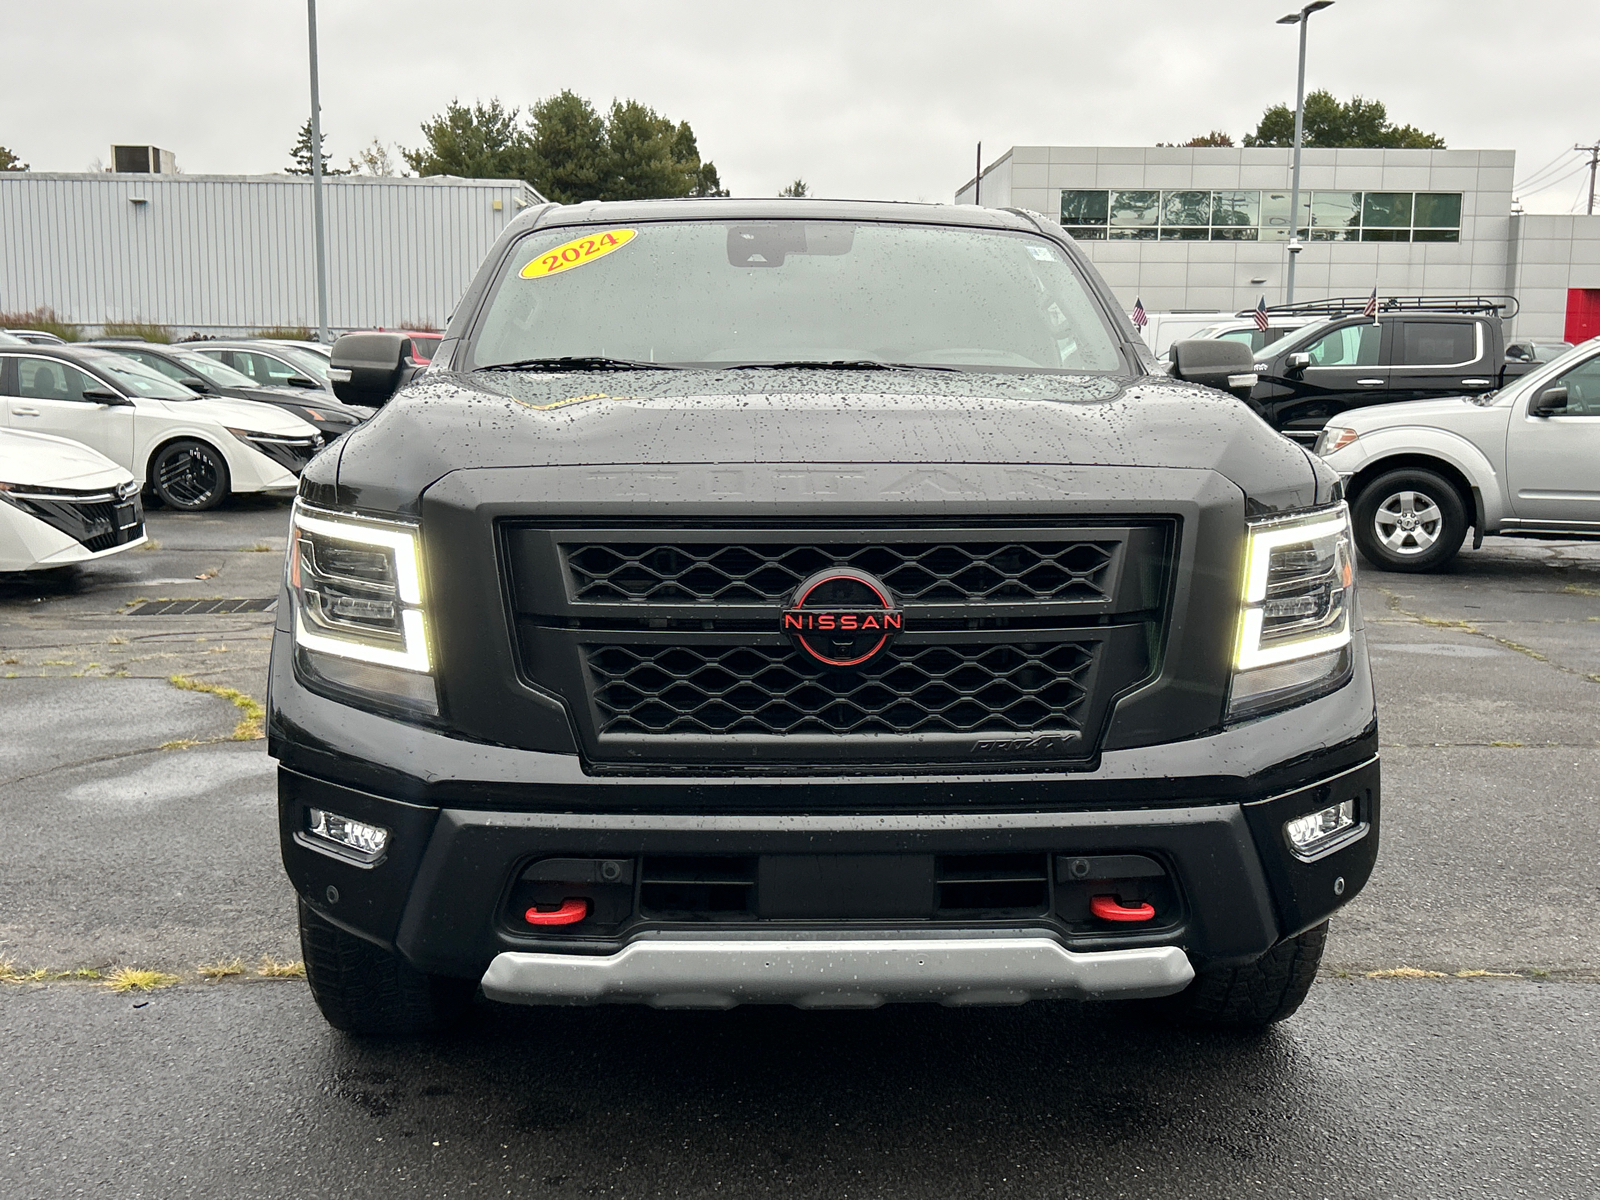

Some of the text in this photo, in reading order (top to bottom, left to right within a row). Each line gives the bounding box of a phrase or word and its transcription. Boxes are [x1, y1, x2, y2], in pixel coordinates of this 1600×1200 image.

[542, 233, 620, 272] 2024
[585, 469, 1089, 496] TITAN
[784, 614, 902, 630] NISSAN
